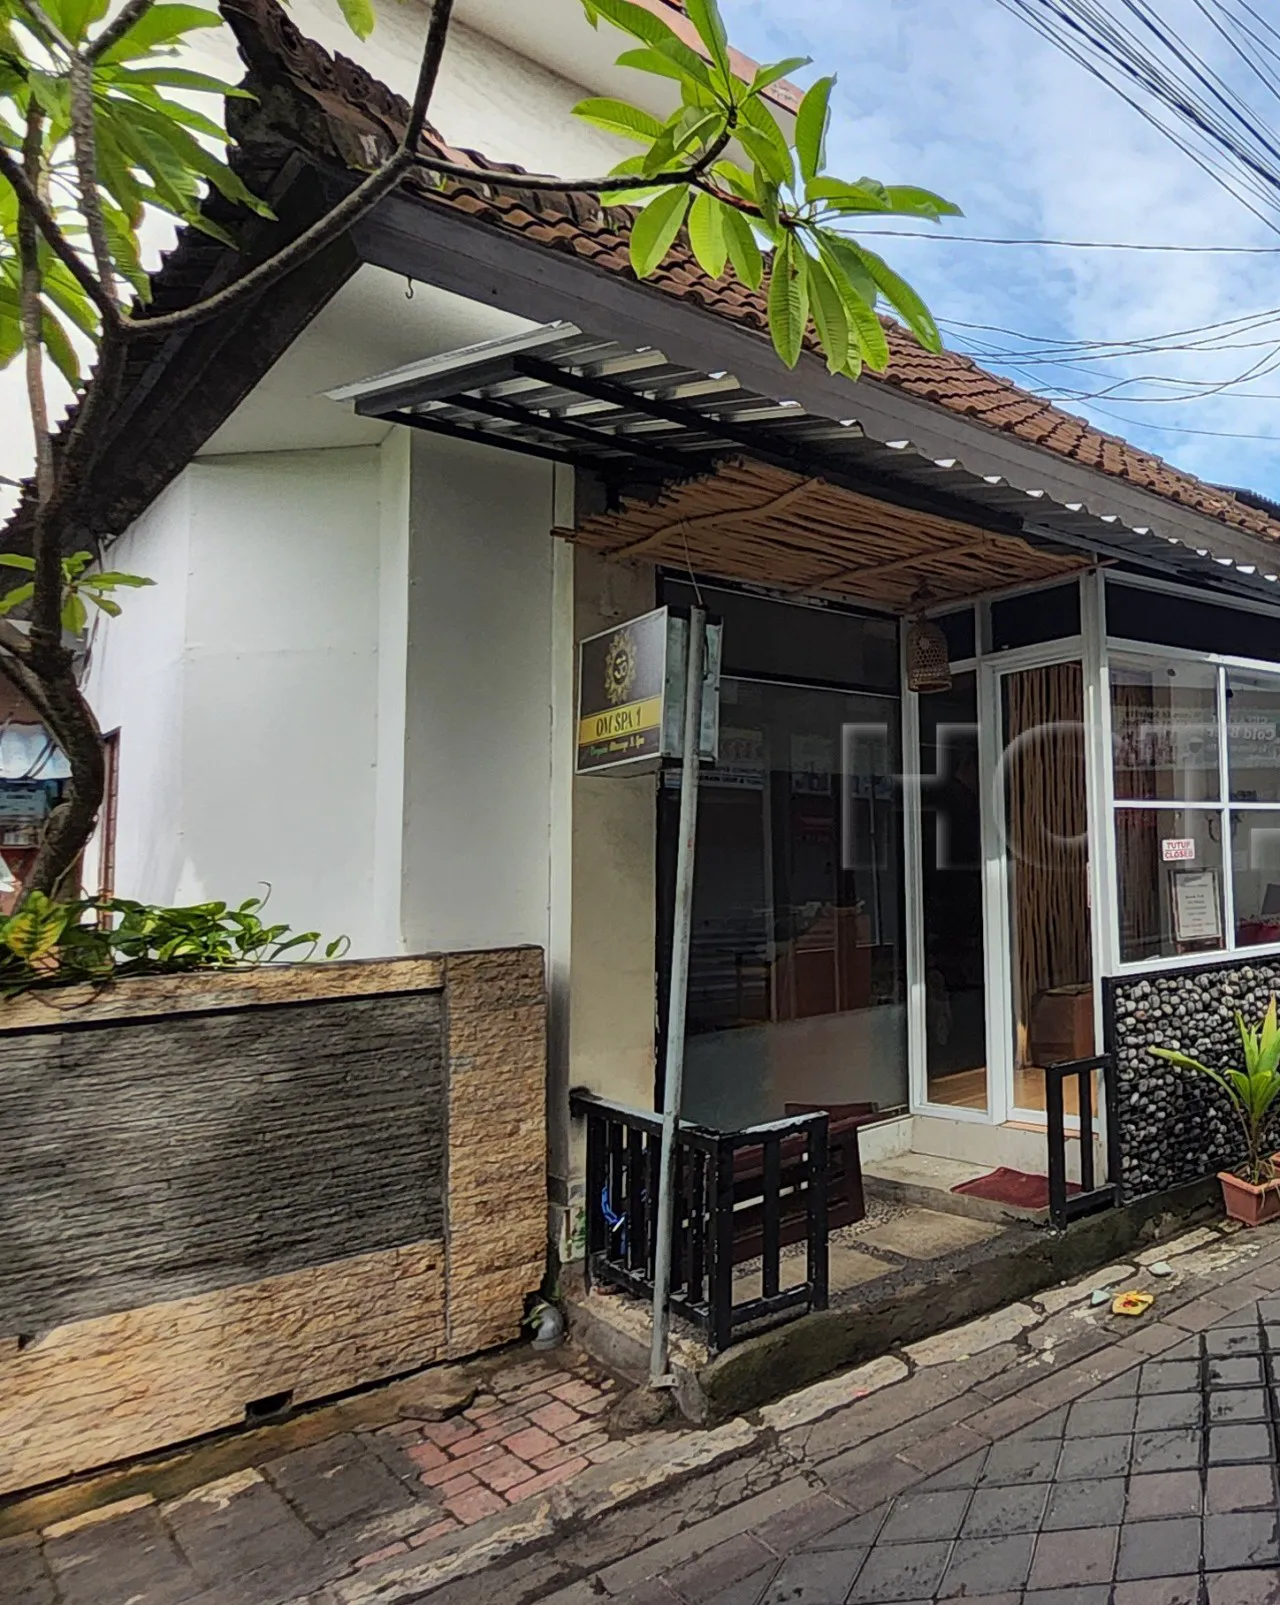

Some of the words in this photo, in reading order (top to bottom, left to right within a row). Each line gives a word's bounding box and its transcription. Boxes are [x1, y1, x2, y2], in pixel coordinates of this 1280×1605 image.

[596, 715, 613, 737] OM
[614, 710, 633, 732] SPA
[636, 706, 641, 727] 1
[1165, 851, 1193, 859] CLOSED
